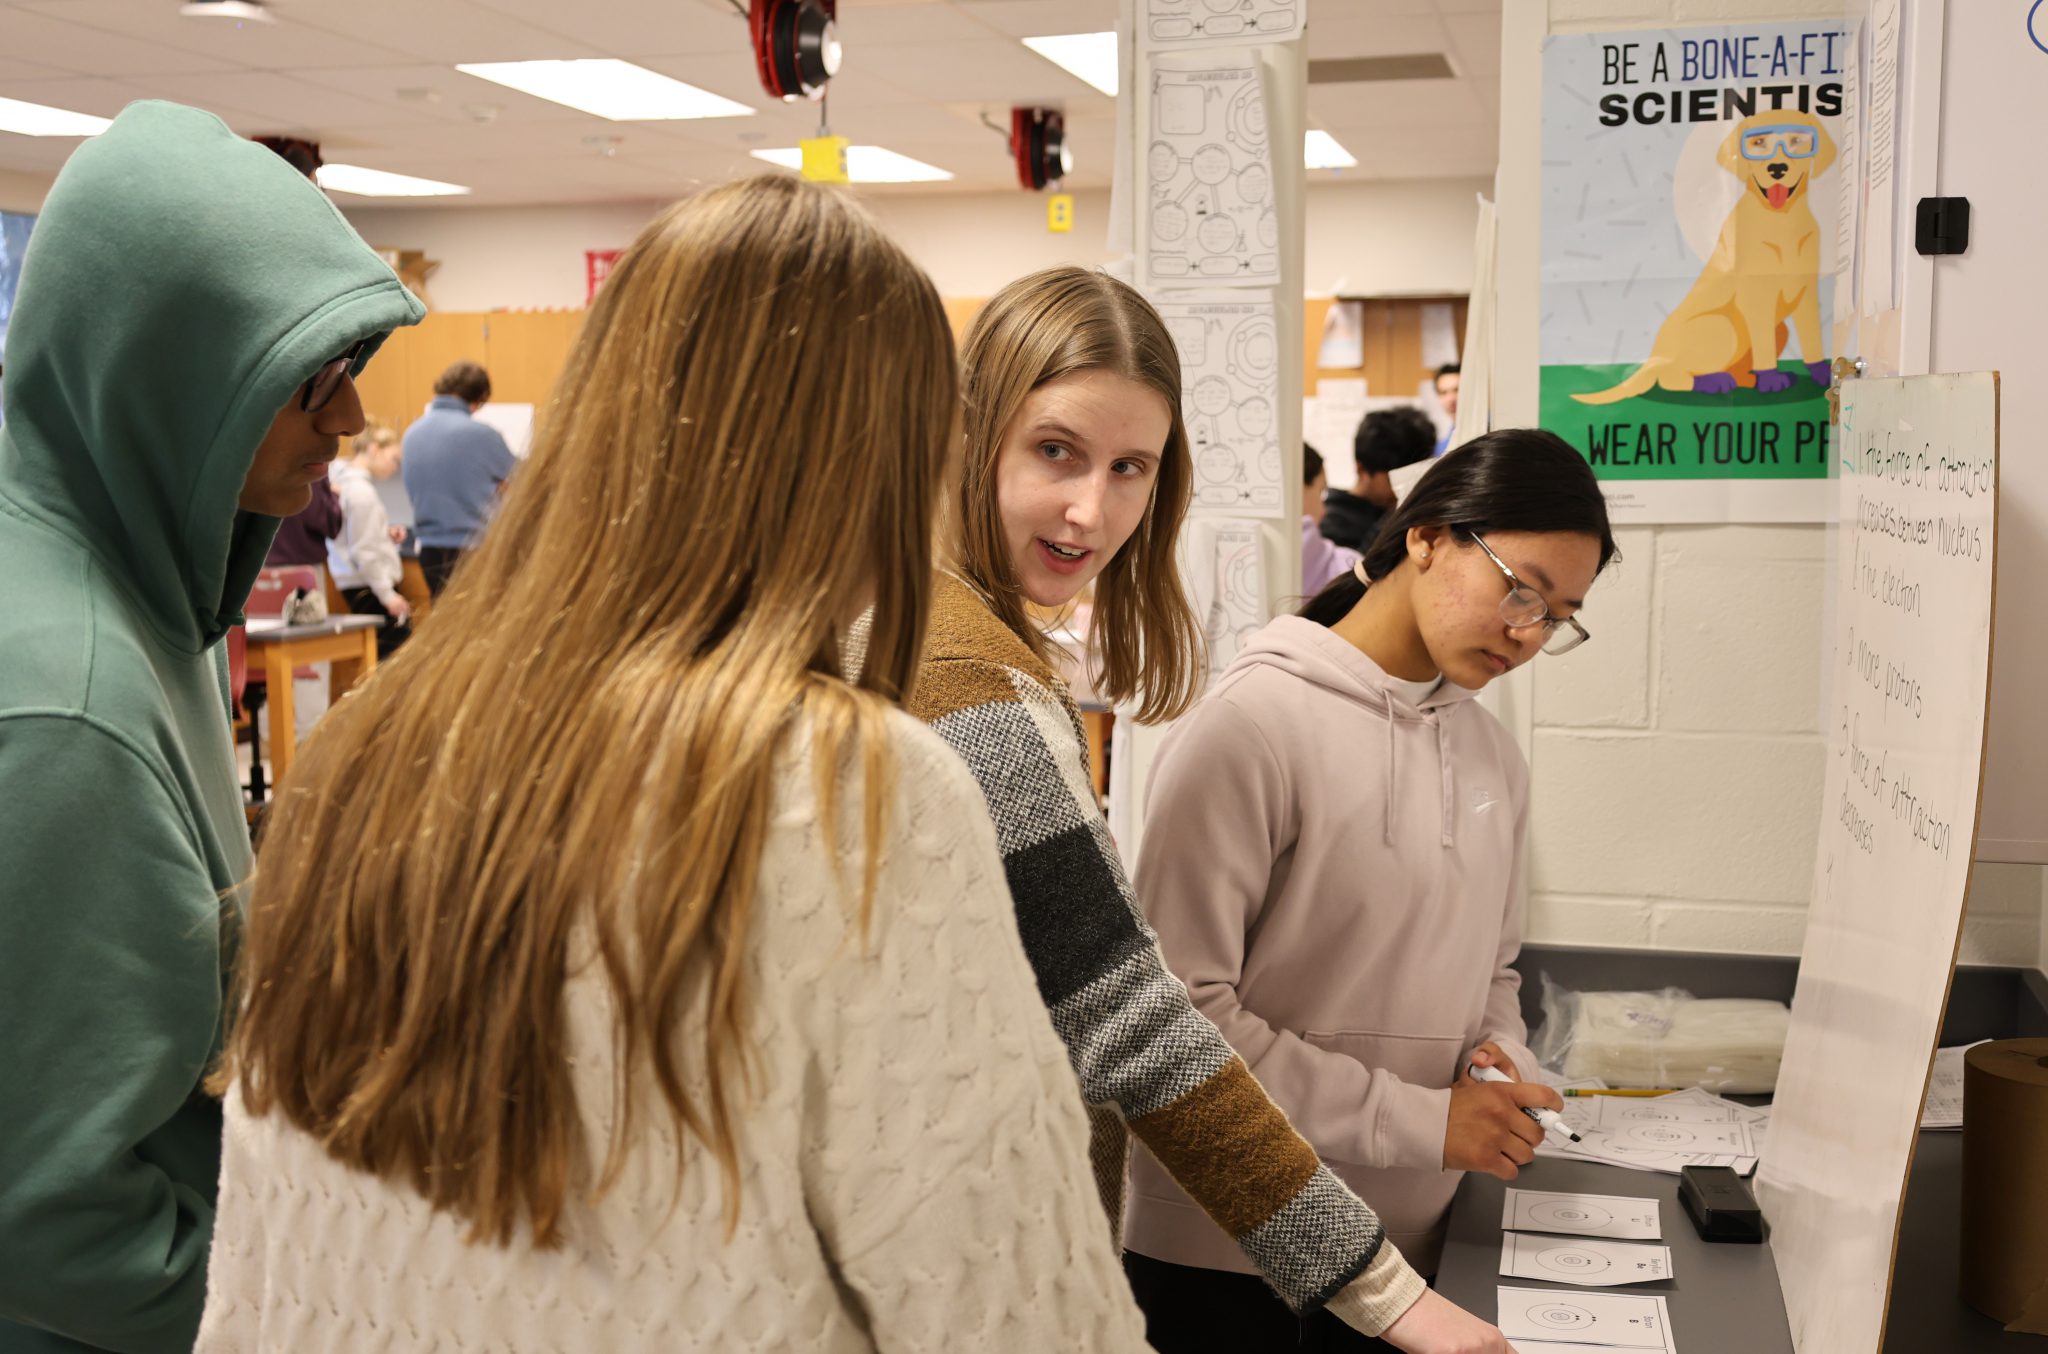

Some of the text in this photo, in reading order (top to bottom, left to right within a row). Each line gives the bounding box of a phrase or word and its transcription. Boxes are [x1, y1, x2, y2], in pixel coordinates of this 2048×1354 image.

[1602, 32, 1845, 86] BE A BONE-A-FI
[1588, 423, 1677, 466] WEAR
[1693, 421, 1780, 465] YOUR
[1886, 432, 1911, 486] force
[1916, 443, 1930, 490] of
[1938, 446, 1995, 498] attraction
[1938, 513, 1982, 562] nucleus
[1885, 661, 1922, 725] protons
[1851, 712, 1870, 789] force
[1873, 750, 1887, 804] of
[1891, 771, 1950, 861] attraction
